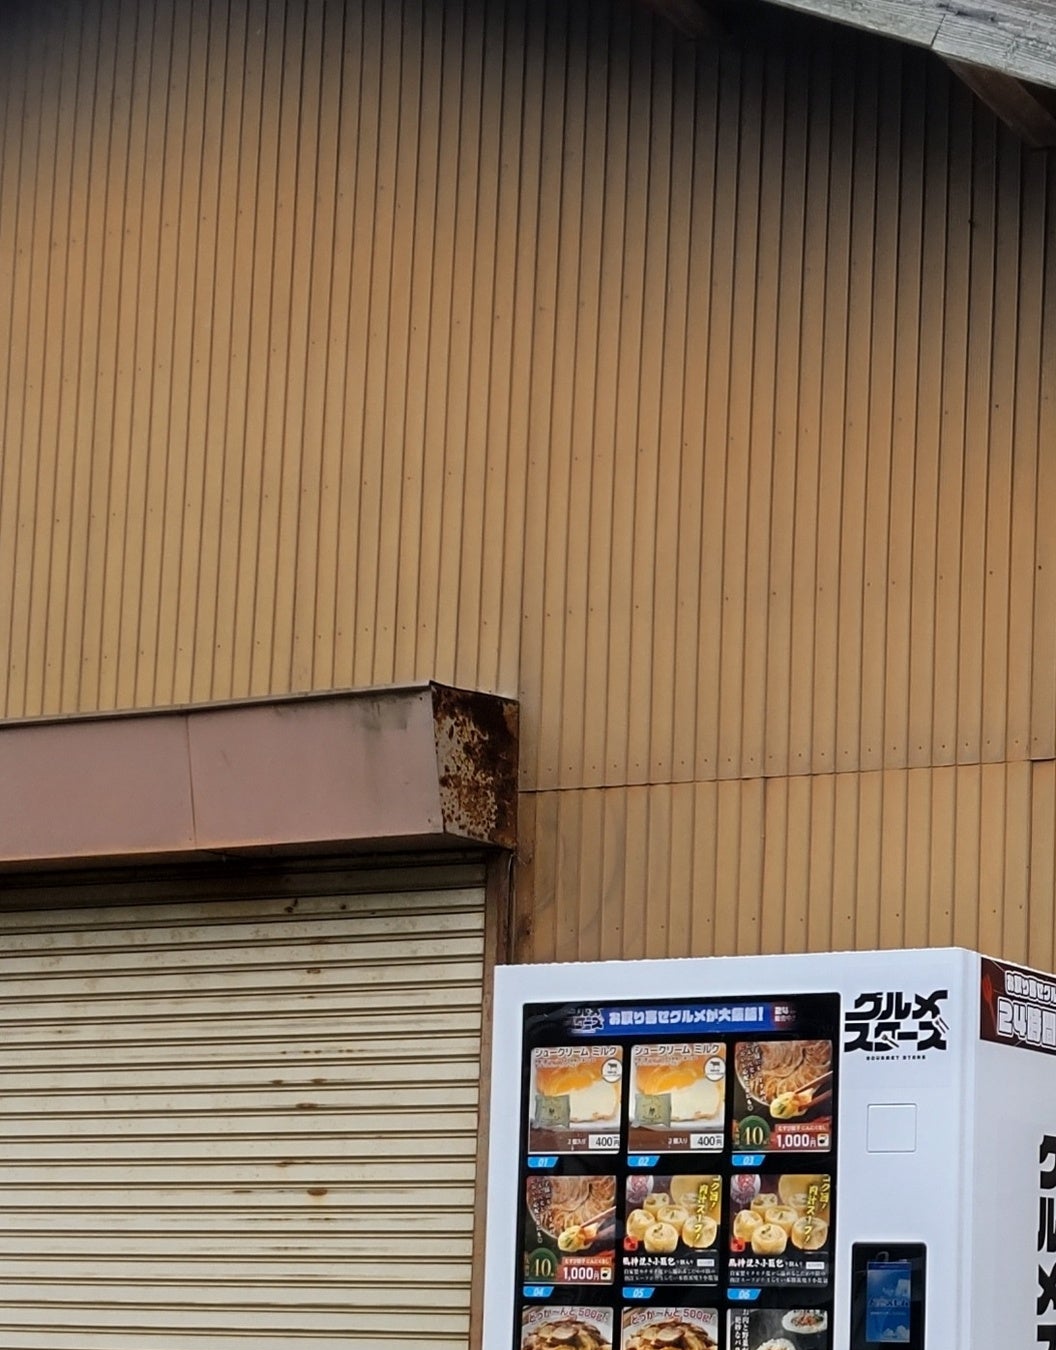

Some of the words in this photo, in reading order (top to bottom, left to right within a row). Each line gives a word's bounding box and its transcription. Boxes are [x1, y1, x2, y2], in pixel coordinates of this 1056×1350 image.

[845, 990, 948, 1020] グルメ
[535, 1048, 589, 1057] シュークリーム
[592, 1046, 617, 1056] ミルク
[635, 1045, 690, 1055] シュークリーム
[695, 1044, 719, 1054] ミルク
[638, 1157, 650, 1166] 02
[743, 1156, 754, 1166] 03
[633, 1288, 644, 1298] 05
[738, 1289, 750, 1299] 06
